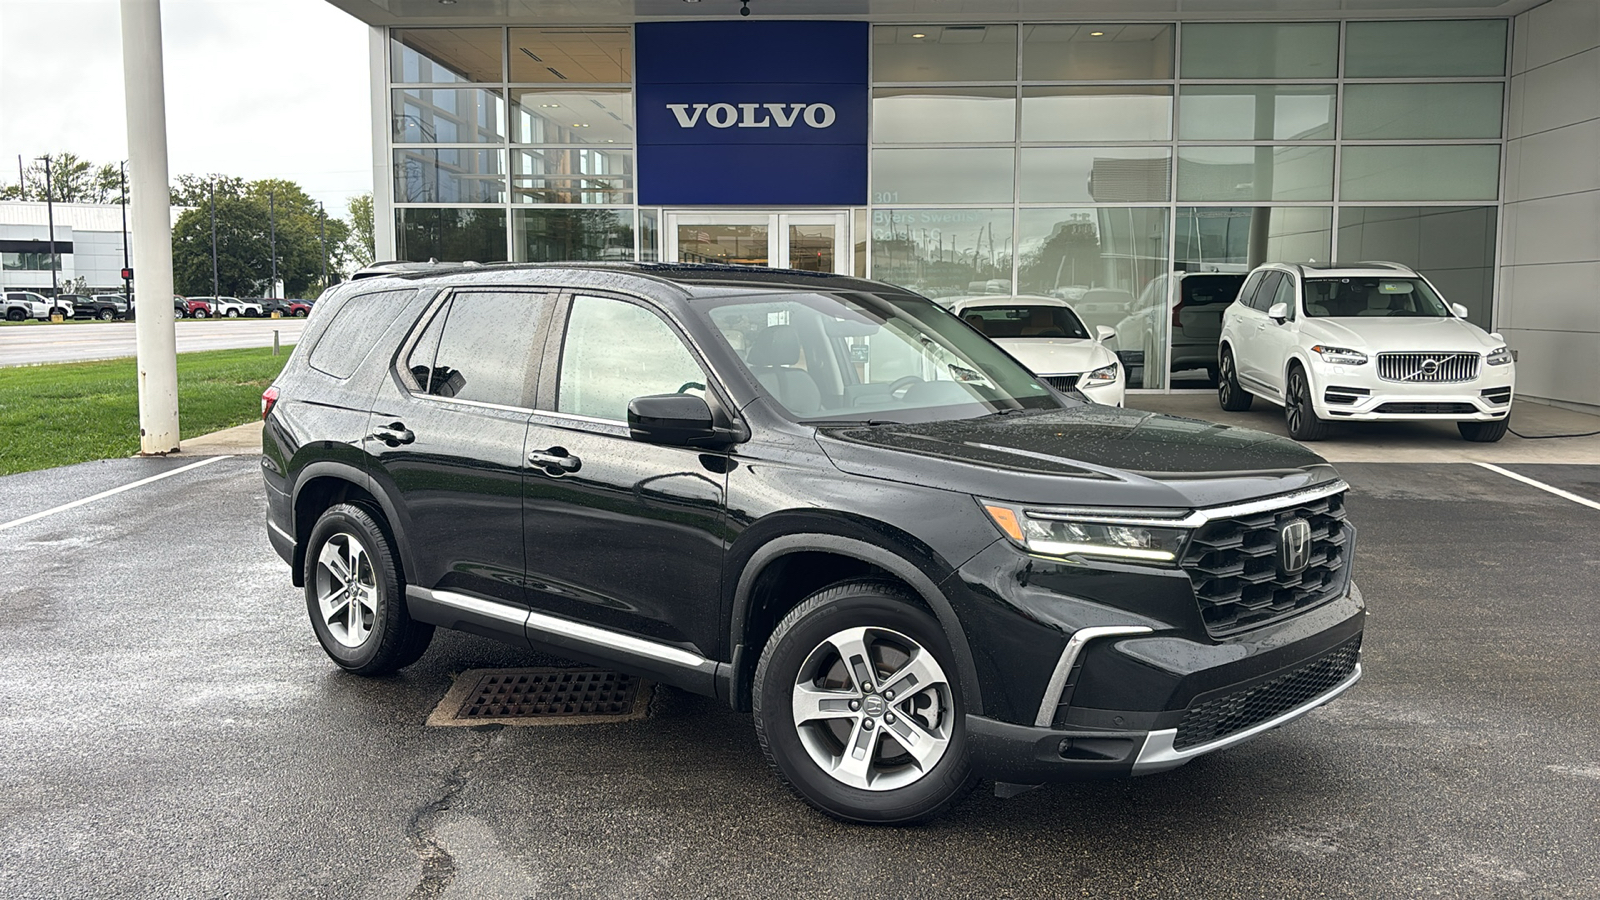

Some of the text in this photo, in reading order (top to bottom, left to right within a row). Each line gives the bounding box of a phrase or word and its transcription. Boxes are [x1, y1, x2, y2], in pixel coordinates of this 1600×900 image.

[666, 102, 836, 128] VOLVO
[874, 191, 898, 204] 301
[874, 211, 915, 226] Byers
[874, 228, 907, 241] Cars
